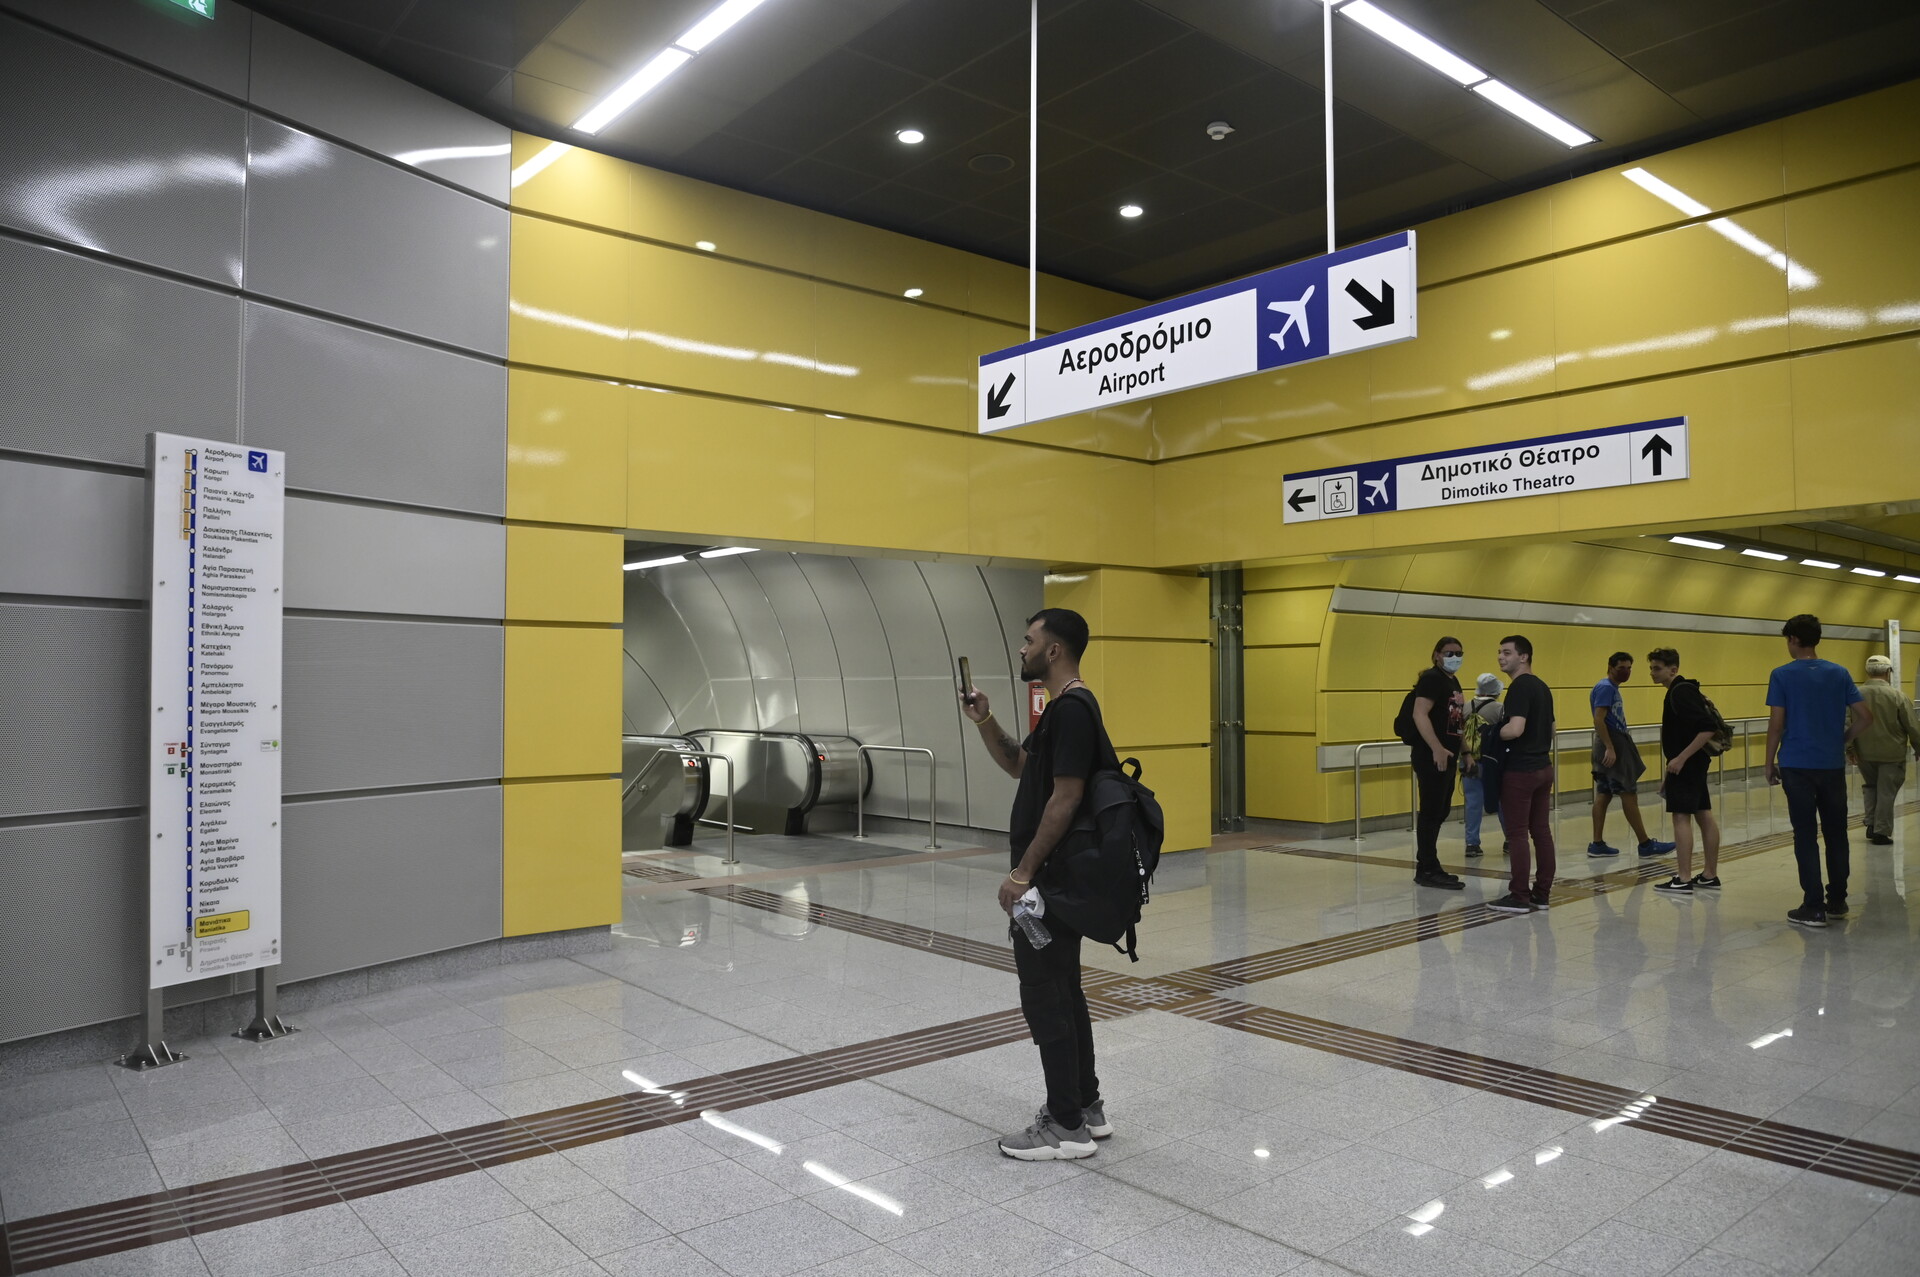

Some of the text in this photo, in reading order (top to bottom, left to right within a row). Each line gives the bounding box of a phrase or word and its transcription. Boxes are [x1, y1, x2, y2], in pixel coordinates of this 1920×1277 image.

[1058, 318, 1211, 374] Αεροδρόμιο
[1098, 363, 1165, 396] Airport
[205, 448, 242, 459] Αεροδρόμιο
[1421, 444, 1600, 482] Δημοτικό Θέατρο
[1441, 473, 1574, 500] Dimotiko Theatro
[203, 507, 231, 516] Παλλήνη
[203, 527, 272, 539] Δουκίσσης Πλακεντίας
[203, 546, 232, 554] Χαλάνδρι
[219, 566, 253, 574] Παρασκευή
[202, 604, 233, 612] Χολαργός
[201, 701, 225, 709] Μέγαρο
[216, 855, 244, 863] Βαρβάρα
[200, 877, 239, 887] Κορυδαλλός
[200, 918, 231, 926] Μανιάτικα
